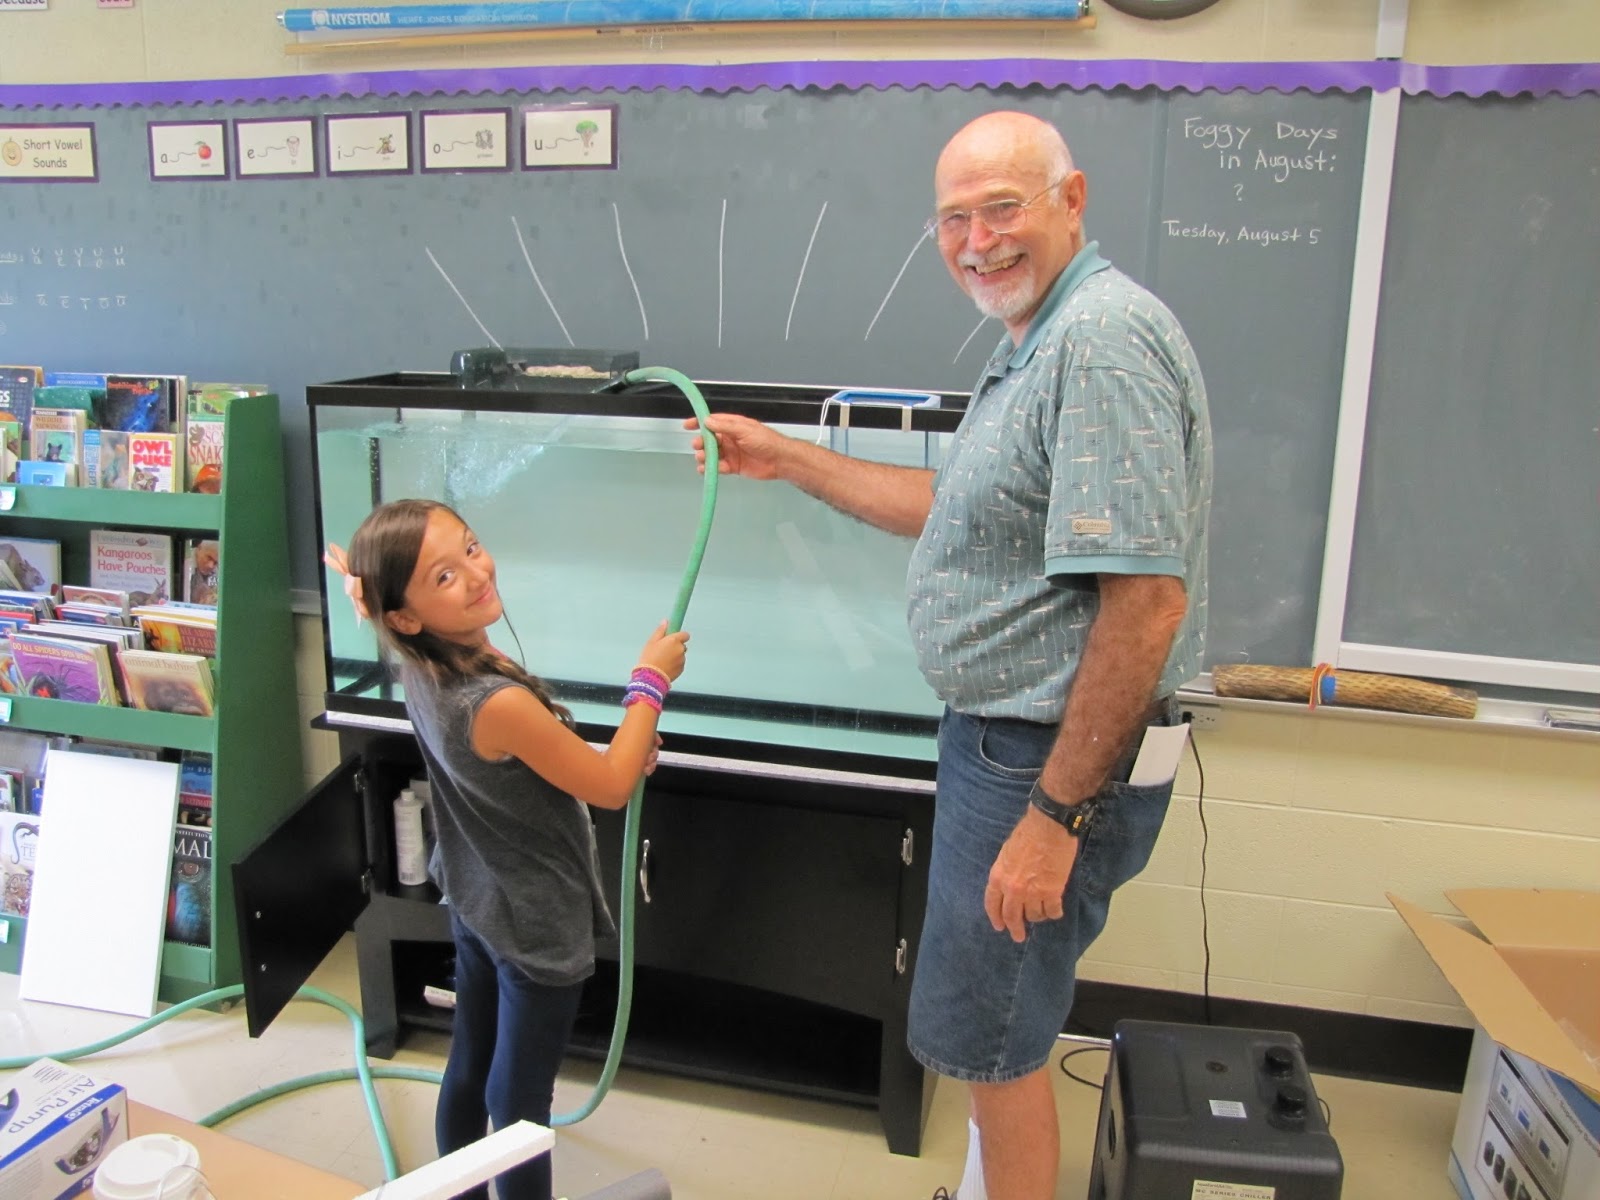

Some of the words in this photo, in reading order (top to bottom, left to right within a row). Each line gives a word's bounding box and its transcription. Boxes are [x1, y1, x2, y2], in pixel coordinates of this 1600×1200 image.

[331, 13, 390, 26] NYSTROM
[426, 15, 453, 24] JONES
[454, 14, 497, 23] EDUCATION
[1184, 117, 1251, 149] Foggy
[1276, 121, 1338, 150] Days
[23, 139, 51, 150] Short
[54, 139, 83, 150] Vowel
[433, 144, 441, 154] o
[534, 139, 543, 150] u
[160, 153, 168, 164] a
[247, 149, 255, 159] e
[337, 146, 341, 160] i
[33, 157, 67, 168] Sounds
[1219, 151, 1241, 169] in
[1254, 149, 1337, 182] August:
[1233, 184, 1244, 201] ?
[1162, 220, 1230, 245] Tuesday,
[1237, 226, 1302, 246] August
[1309, 229, 1322, 244] 5
[132, 440, 172, 454] OWL
[132, 454, 172, 467] PUKE
[97, 546, 153, 561] Kangaroos
[97, 560, 123, 571] Have
[126, 562, 167, 575] Pouches
[12, 642, 21, 650] DO
[22, 644, 33, 652] ALL
[35, 645, 61, 656] SPIDERS
[60, 649, 76, 658] SPIN
[68, 1078, 95, 1097] Air
[8, 1097, 69, 1134] Pump
